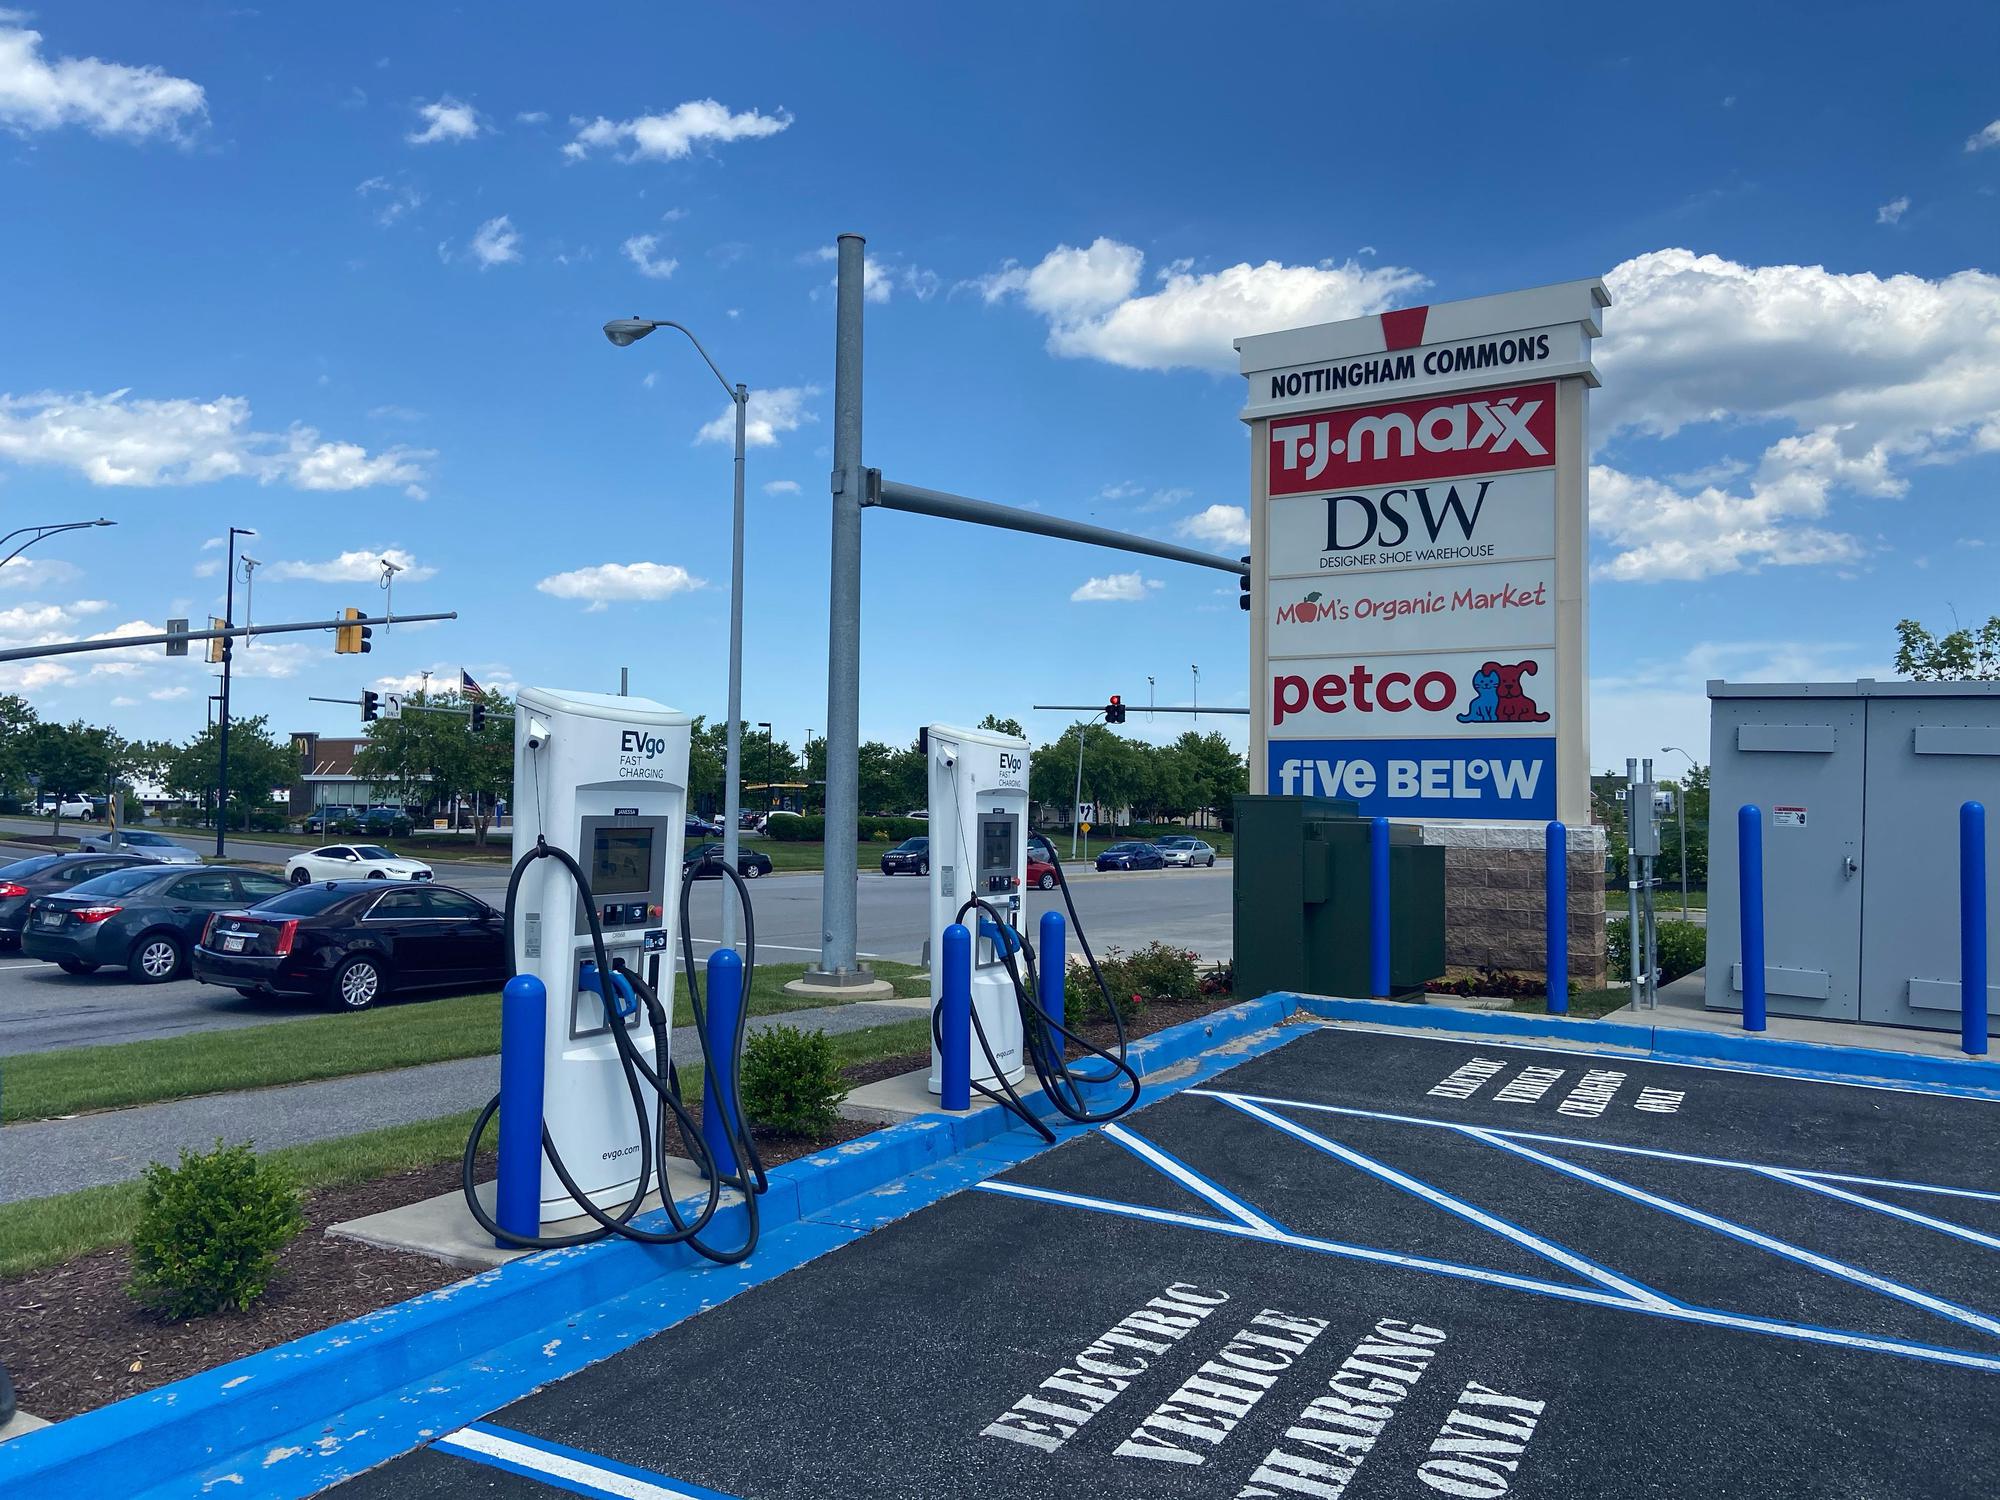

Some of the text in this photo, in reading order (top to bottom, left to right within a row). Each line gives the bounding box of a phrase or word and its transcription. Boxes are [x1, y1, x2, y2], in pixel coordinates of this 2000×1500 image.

[1271, 334, 1550, 398] NOTTINGHAM COMMONS
[1321, 481, 1494, 552] DSW
[1320, 544, 1494, 568] DESIGNER SHOE WAREHOUSE
[1354, 591, 1446, 621] Organic
[1451, 582, 1546, 611] Market
[1273, 665, 1457, 726] petco
[620, 755, 643, 766] FAST
[621, 730, 665, 760] EVgo
[1000, 753, 1022, 774] EVgo
[619, 767, 664, 779] CHARGING
[999, 770, 1011, 778] FAST
[1279, 759, 1377, 798] five
[1427, 1057, 1508, 1100] ELECTRIC
[1492, 1065, 1566, 1104] VEHICLE
[1556, 1068, 1628, 1118] CHARGING
[1634, 1086, 1686, 1113] ONLY
[602, 1144, 640, 1160] evgo.com
[979, 1282, 1230, 1454] ELECTRIC
[1112, 1308, 1331, 1466] VEHICLE
[1416, 1380, 1546, 1499] ONLY
